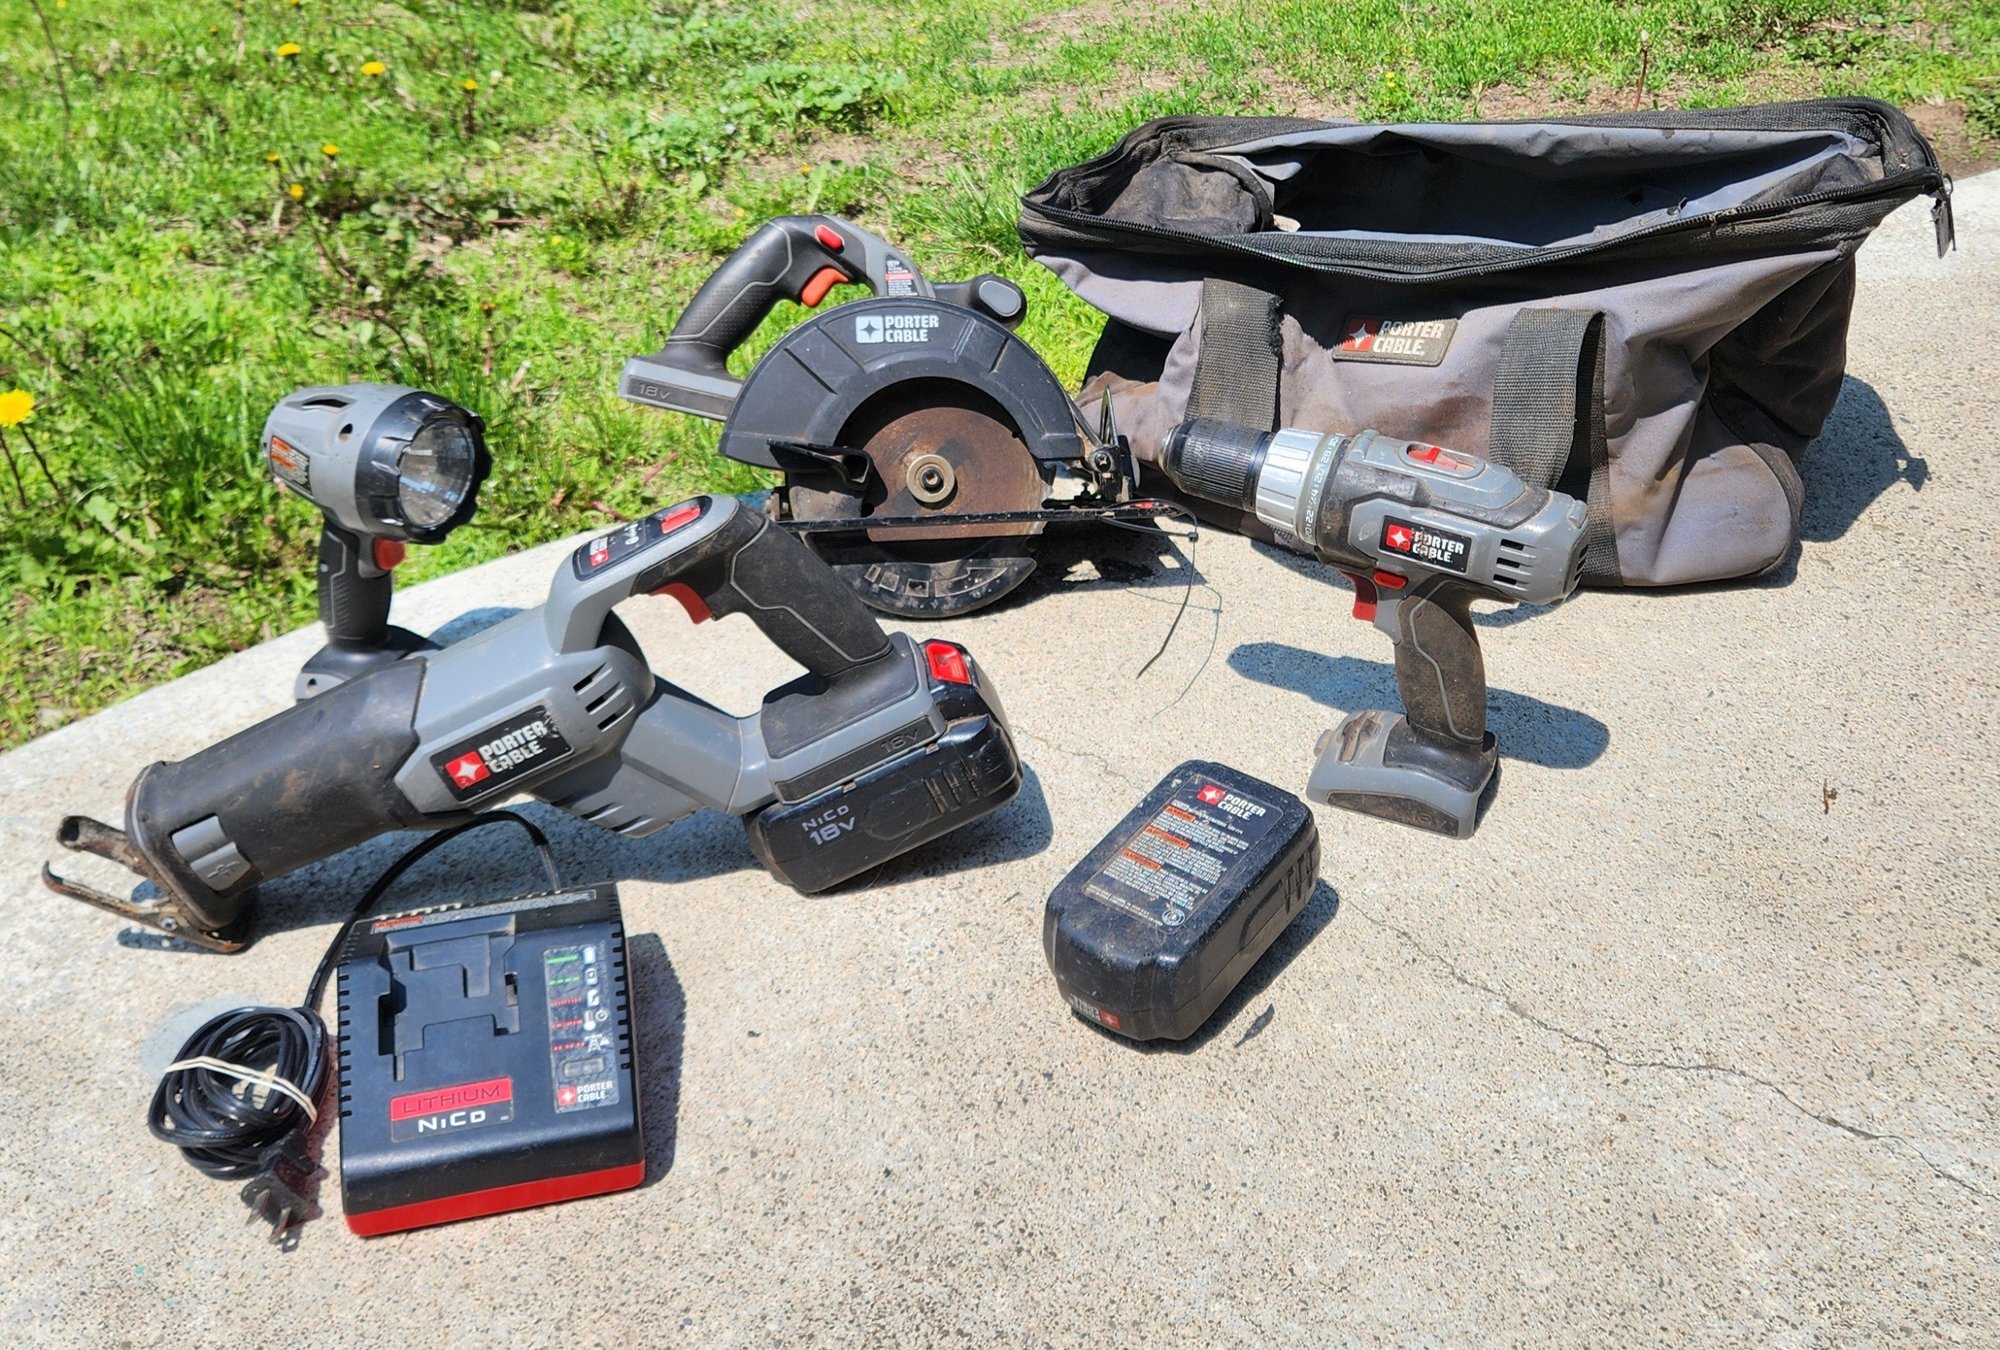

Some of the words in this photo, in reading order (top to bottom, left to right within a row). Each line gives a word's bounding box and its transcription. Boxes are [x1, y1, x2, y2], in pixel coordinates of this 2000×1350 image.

[884, 314, 939, 329] PORTER
[1380, 320, 1445, 339] PORTER
[884, 329, 929, 343] CABLE
[1373, 338, 1425, 356] CABLE
[1306, 510, 1315, 523] 22
[1413, 530, 1465, 555] PORTER
[1412, 543, 1452, 563] CABLE
[478, 720, 549, 762] PORTER
[487, 740, 545, 774] CABLE
[1217, 801, 1252, 821] CABLE
[1223, 793, 1266, 818] PORTER
[809, 816, 856, 846] 18V
[576, 1080, 614, 1093] PORTER
[403, 1085, 501, 1114] LITHIUM
[577, 1091, 607, 1103] CABLE
